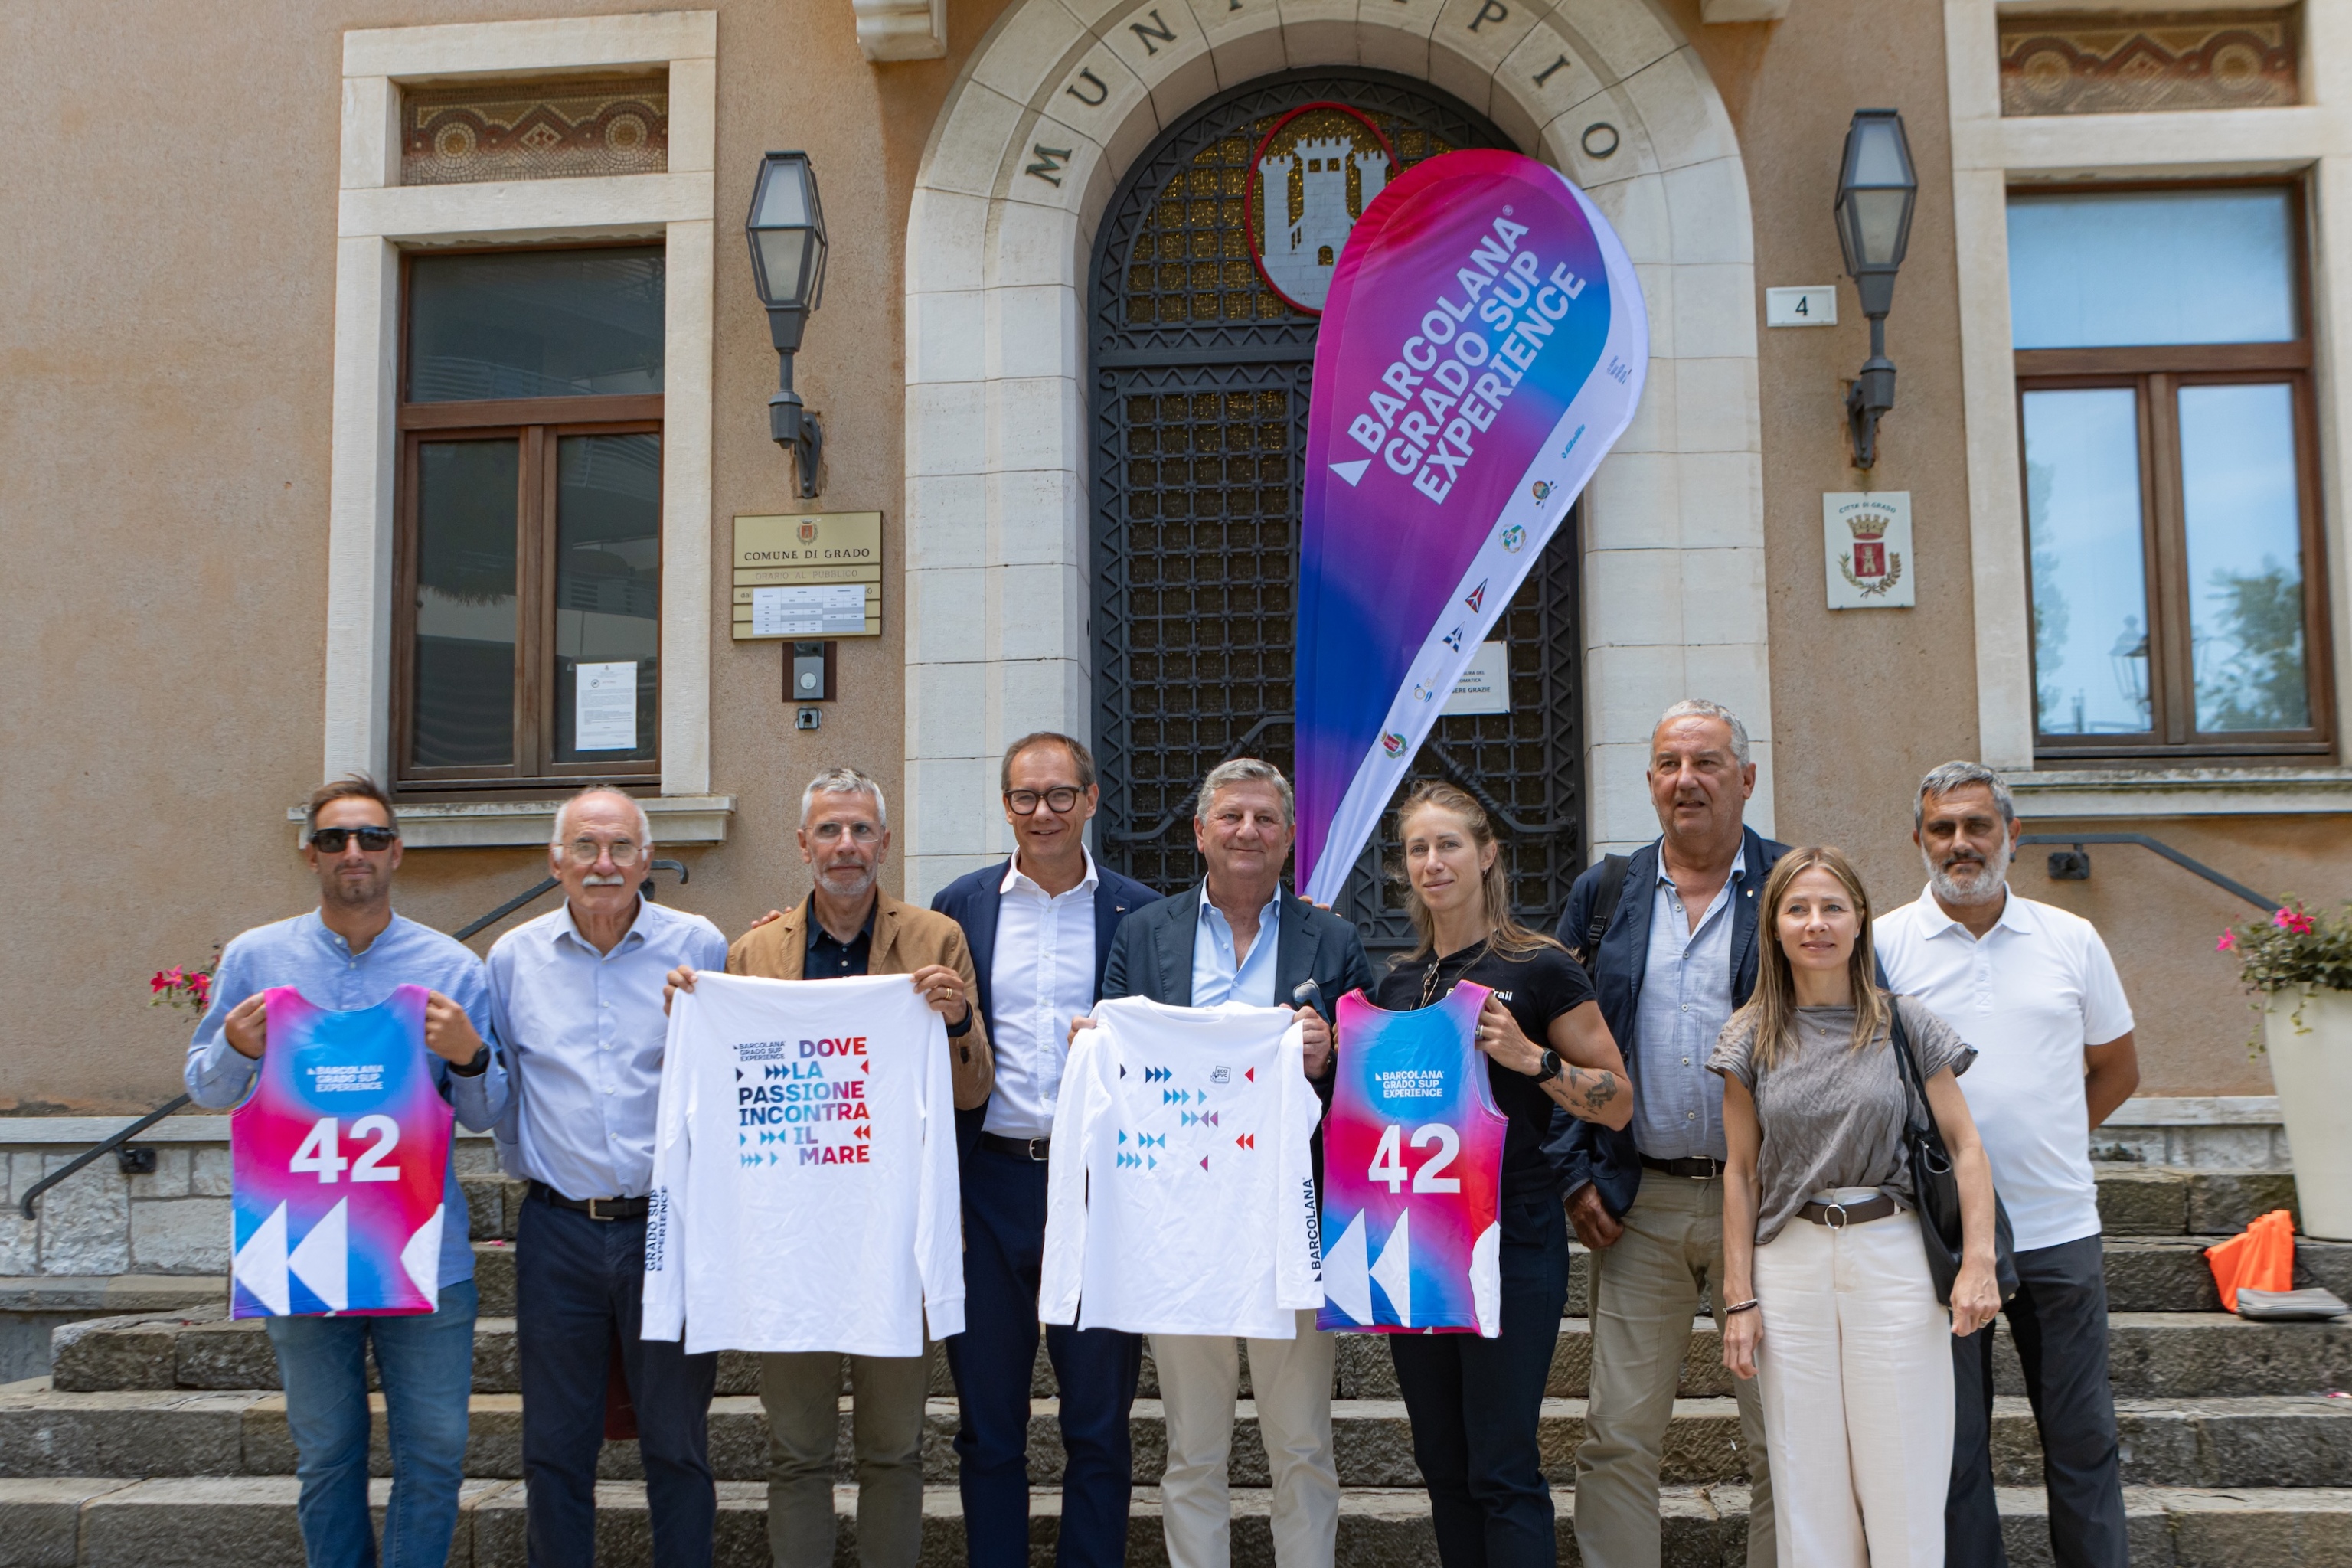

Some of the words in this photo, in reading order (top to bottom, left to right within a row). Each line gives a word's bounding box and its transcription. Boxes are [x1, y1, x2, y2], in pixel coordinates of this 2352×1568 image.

[1025, 0, 1619, 188] MUNPIO
[1795, 296, 1808, 315] 4
[1384, 331, 1489, 476] GRADO
[1480, 250, 1539, 332] SUP
[1412, 261, 1586, 505] EXPERIENCE
[1871, 501, 1896, 514] GRADO
[744, 550, 798, 560] COMUNE
[805, 550, 818, 559] DI
[824, 548, 870, 558] GRADO
[755, 572, 789, 580] ORARIO
[812, 570, 858, 578] PUBBLICO
[799, 1037, 867, 1058] DOVE
[740, 1054, 785, 1062] EXPERIENCE
[315, 1065, 384, 1075] BARCOLANA
[315, 1074, 356, 1083] GRADO
[358, 1073, 381, 1083] SUP
[792, 1060, 824, 1080] LA
[315, 1081, 384, 1093] EXPERIENCE
[739, 1080, 864, 1105] PASSIONE
[1383, 1080, 1416, 1089] GRADO
[1418, 1079, 1439, 1088] SUP
[1383, 1088, 1443, 1098] EXPERIENCE
[739, 1102, 870, 1126] INCONTRA
[793, 1126, 818, 1145] IL
[289, 1114, 400, 1184] 42
[799, 1145, 870, 1166] MARE
[1367, 1122, 1461, 1194] 42
[648, 1189, 658, 1217] SUP
[657, 1185, 668, 1271] EXPERIENCE
[645, 1221, 658, 1271] GRADO
